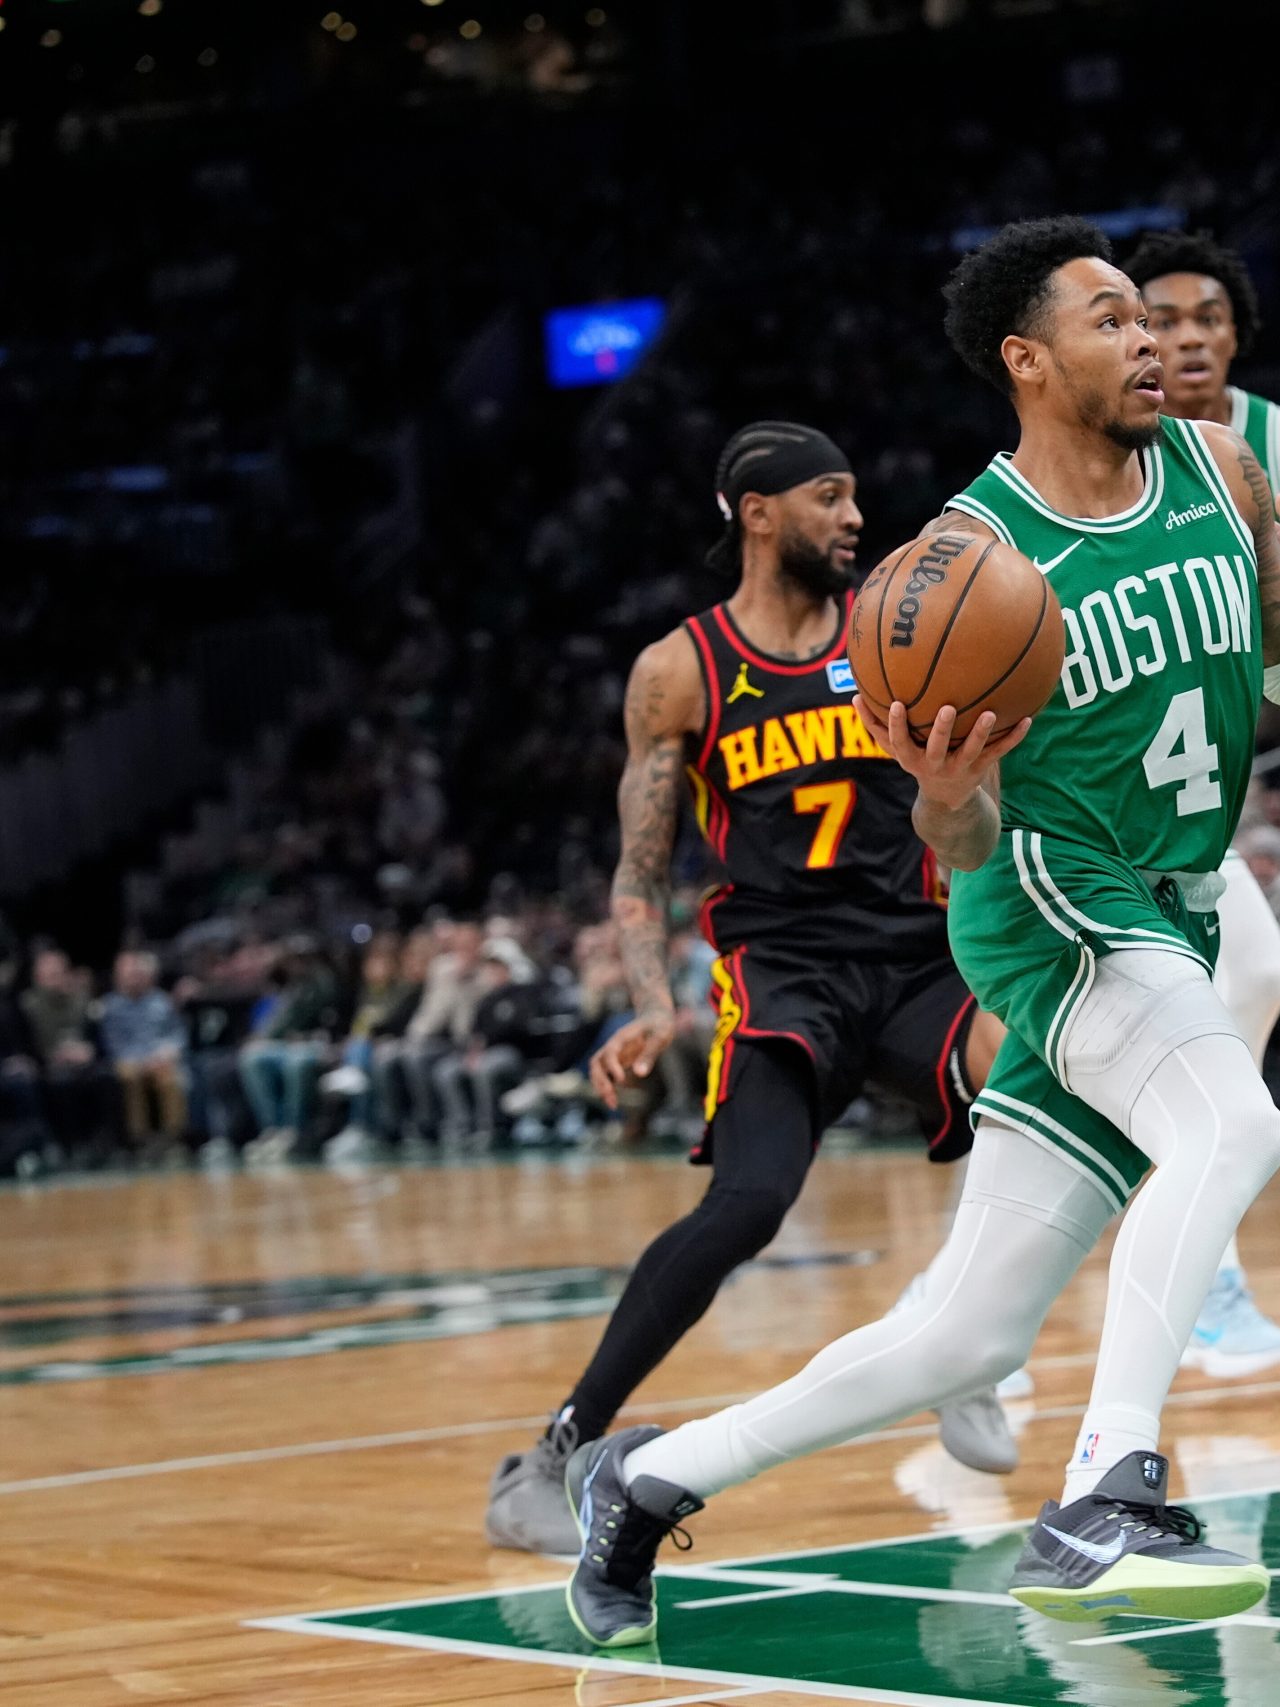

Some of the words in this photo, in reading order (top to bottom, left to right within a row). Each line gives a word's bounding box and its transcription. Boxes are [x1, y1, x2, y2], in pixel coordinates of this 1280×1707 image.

[1165, 502, 1219, 531] Amica
[888, 535, 976, 649] Wilson
[1060, 555, 1252, 711] BOSTON
[717, 704, 894, 791] HAWK
[1142, 686, 1223, 817] 4
[792, 779, 857, 870] 7
